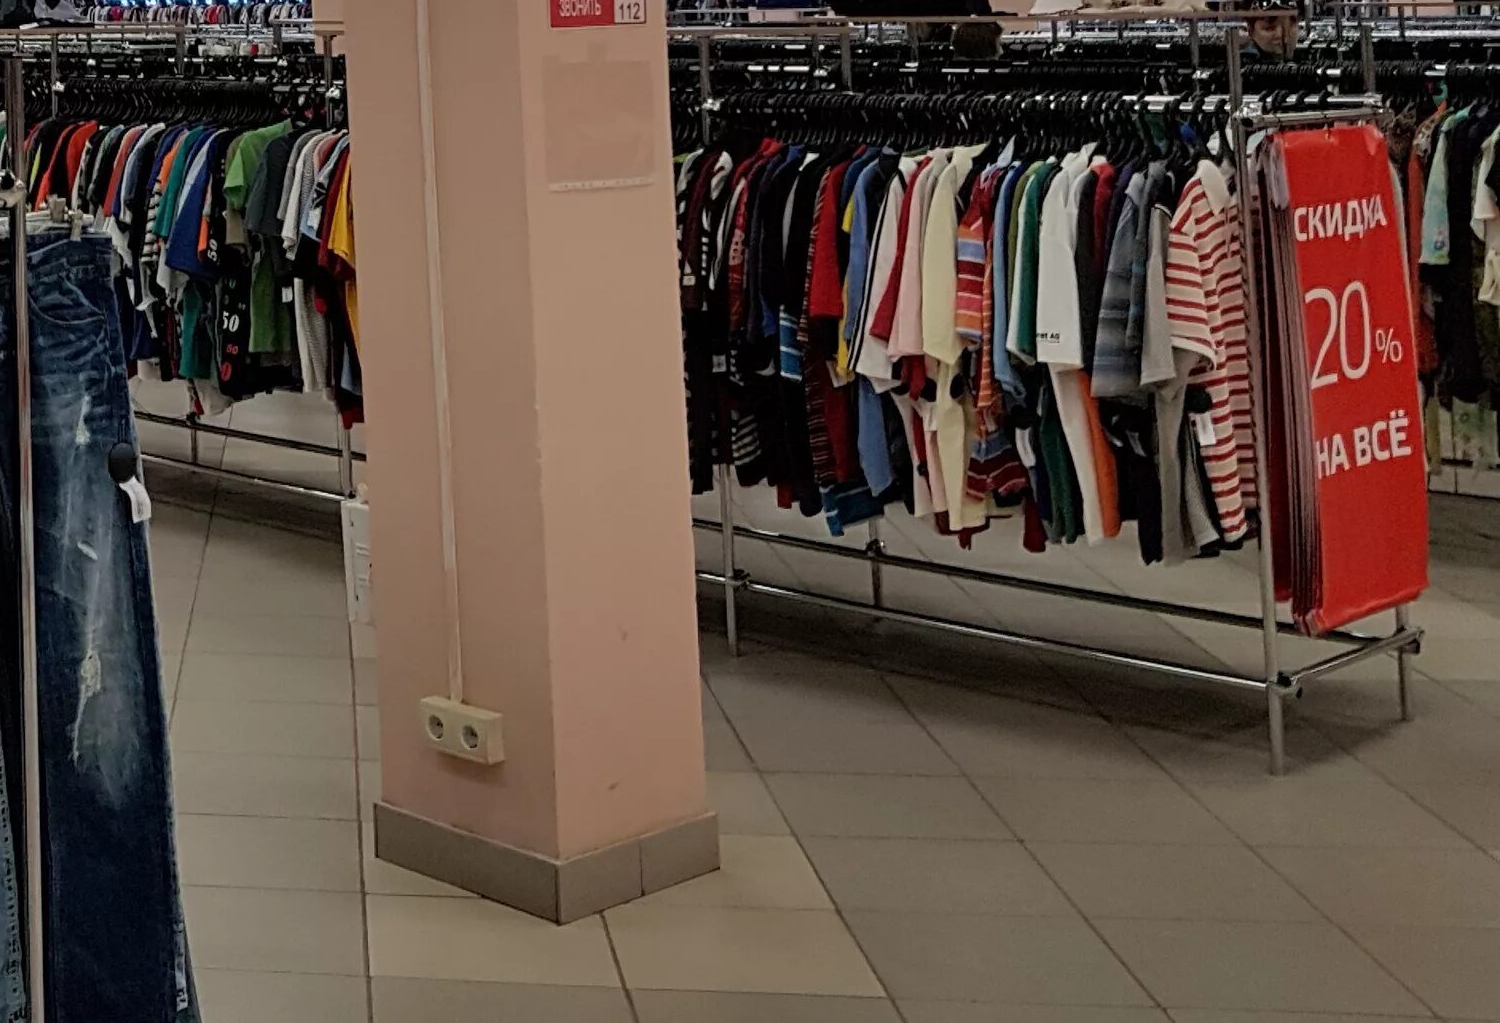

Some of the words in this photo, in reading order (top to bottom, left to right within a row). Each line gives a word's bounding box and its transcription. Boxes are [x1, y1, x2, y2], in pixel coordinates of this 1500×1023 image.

[619, 2, 640, 20] 112
[1293, 194, 1387, 241] СКИДКА
[1304, 280, 1403, 390] 20%
[1315, 433, 1350, 479] НА
[1353, 409, 1412, 468] ВСЁ
